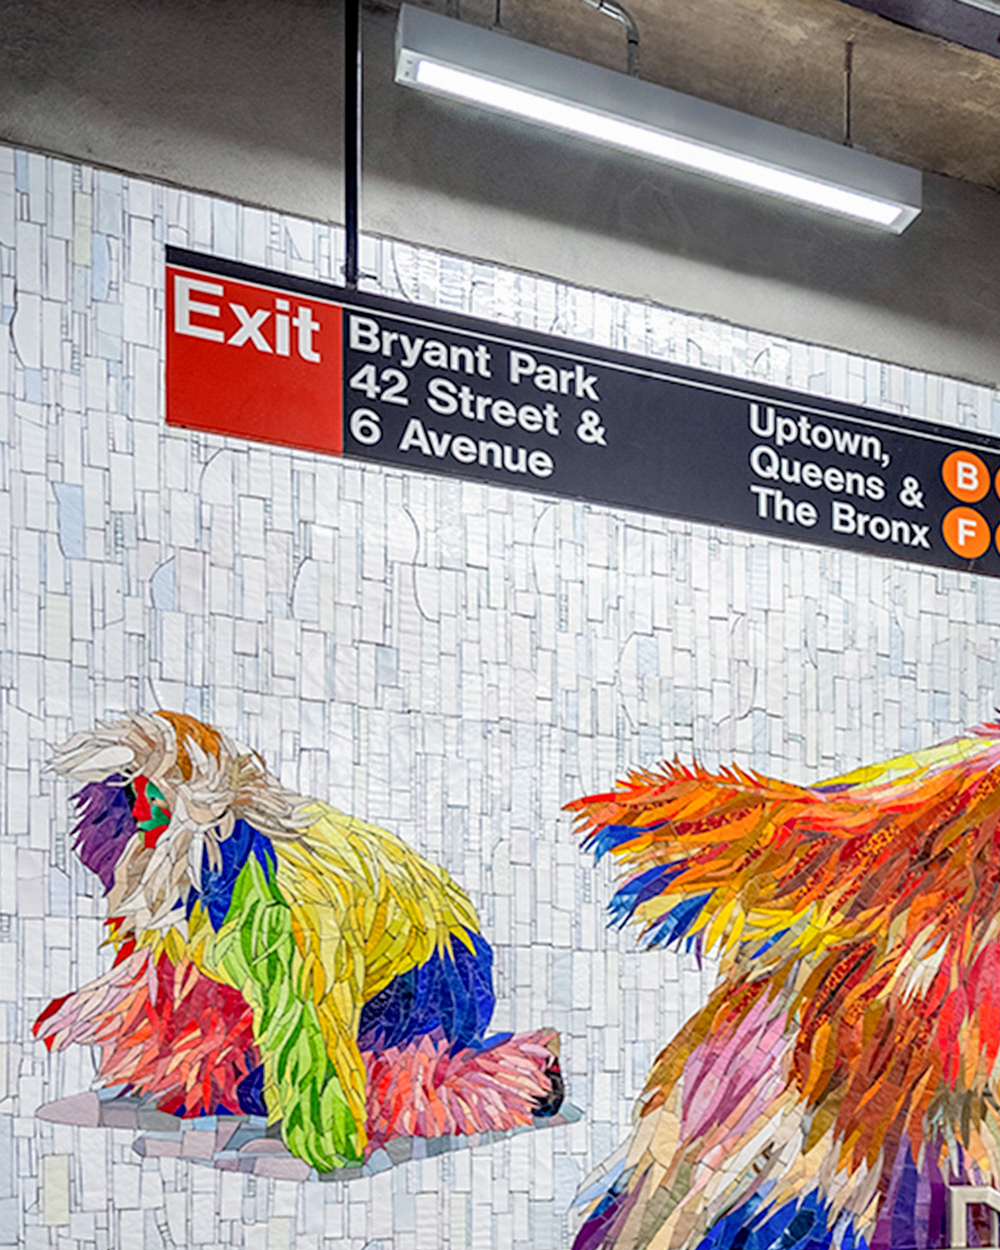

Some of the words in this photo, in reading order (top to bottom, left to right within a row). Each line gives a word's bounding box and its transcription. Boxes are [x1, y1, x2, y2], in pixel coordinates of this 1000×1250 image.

[173, 276, 320, 362] Exit
[349, 316, 492, 378] Bryant
[510, 350, 600, 401] Park
[349, 364, 409, 406] 42
[427, 377, 560, 437] Street
[576, 409, 607, 446] &
[749, 404, 891, 468] Uptown,
[350, 408, 382, 446] 6
[400, 420, 554, 478] Avenue
[749, 445, 886, 501] Queens
[899, 475, 926, 509] &
[956, 460, 979, 491] B
[749, 485, 819, 528] The
[831, 500, 931, 549] Bronx
[957, 519, 977, 548] F
